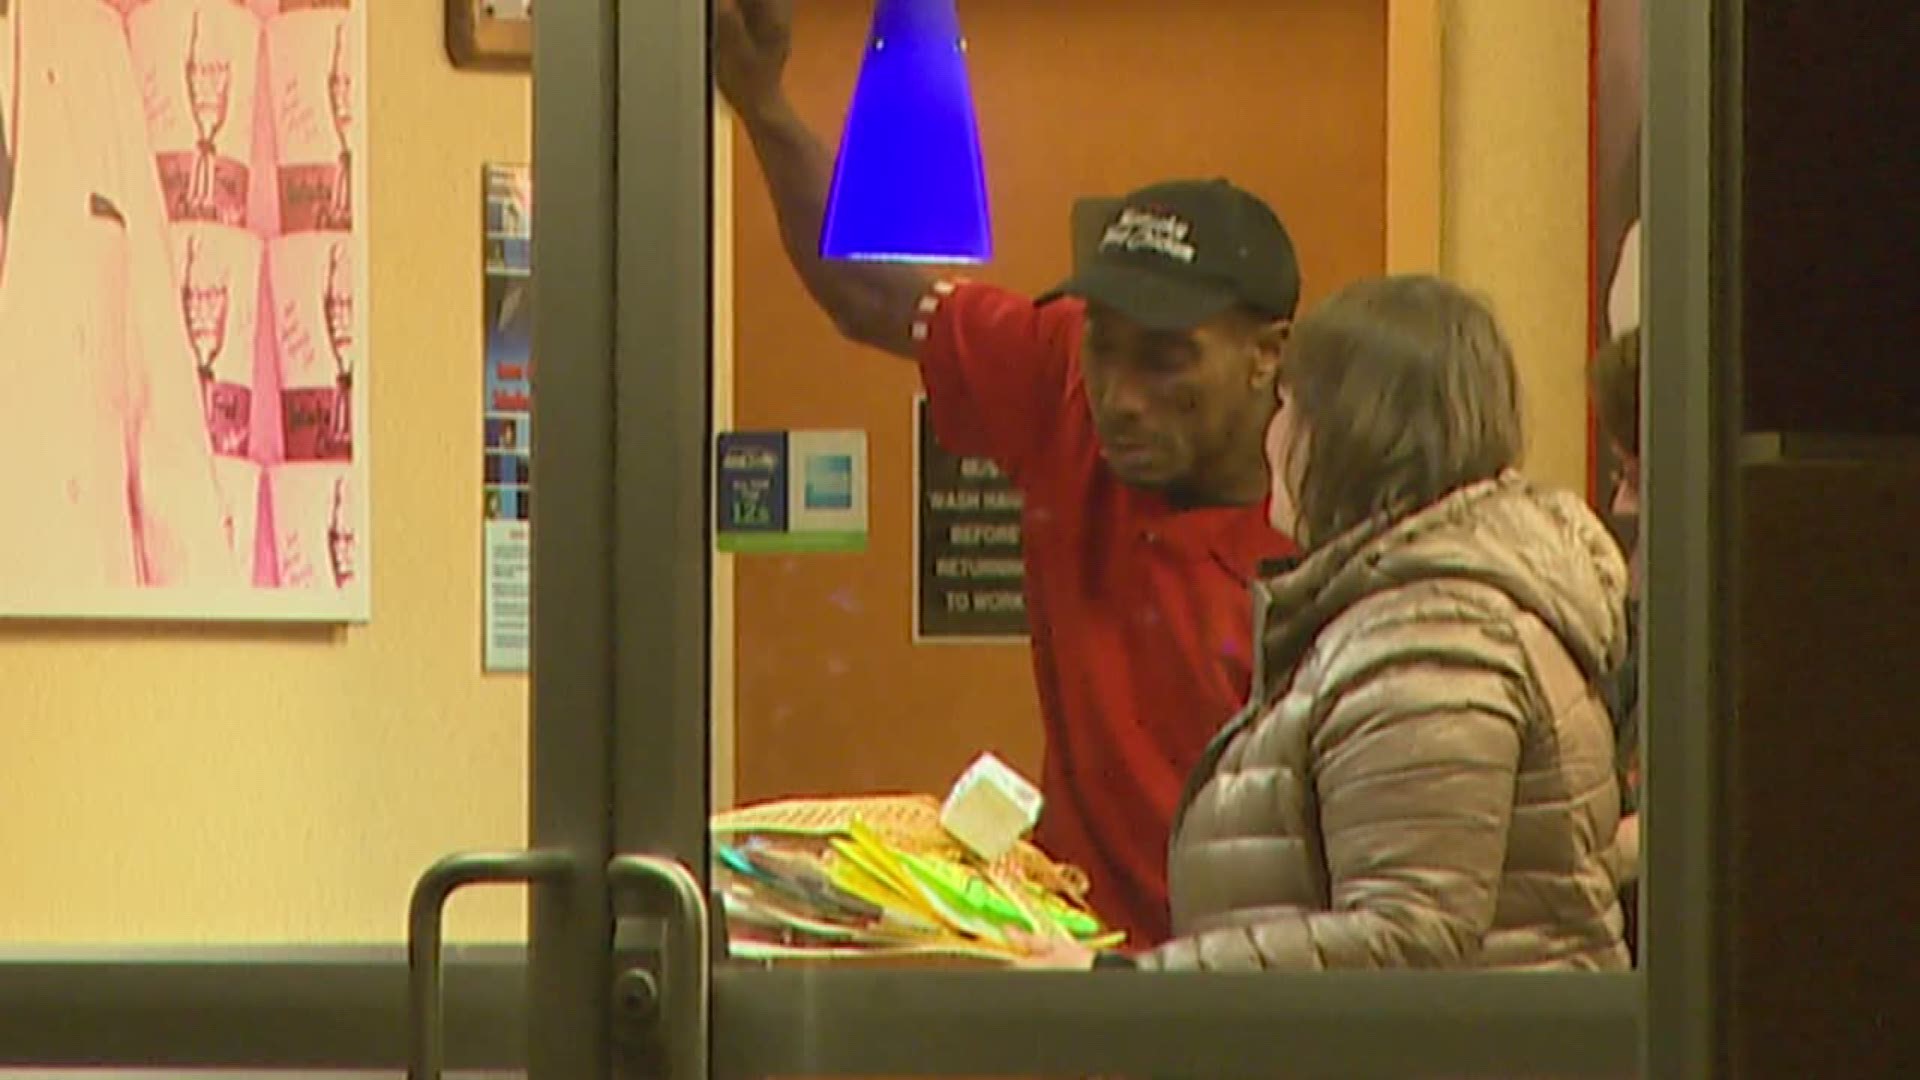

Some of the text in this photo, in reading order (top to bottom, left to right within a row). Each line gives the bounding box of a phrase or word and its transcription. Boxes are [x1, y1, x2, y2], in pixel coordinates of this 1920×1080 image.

[930, 489, 981, 510] WASH
[950, 524, 1021, 545] BEFORE
[946, 591, 970, 612] TO
